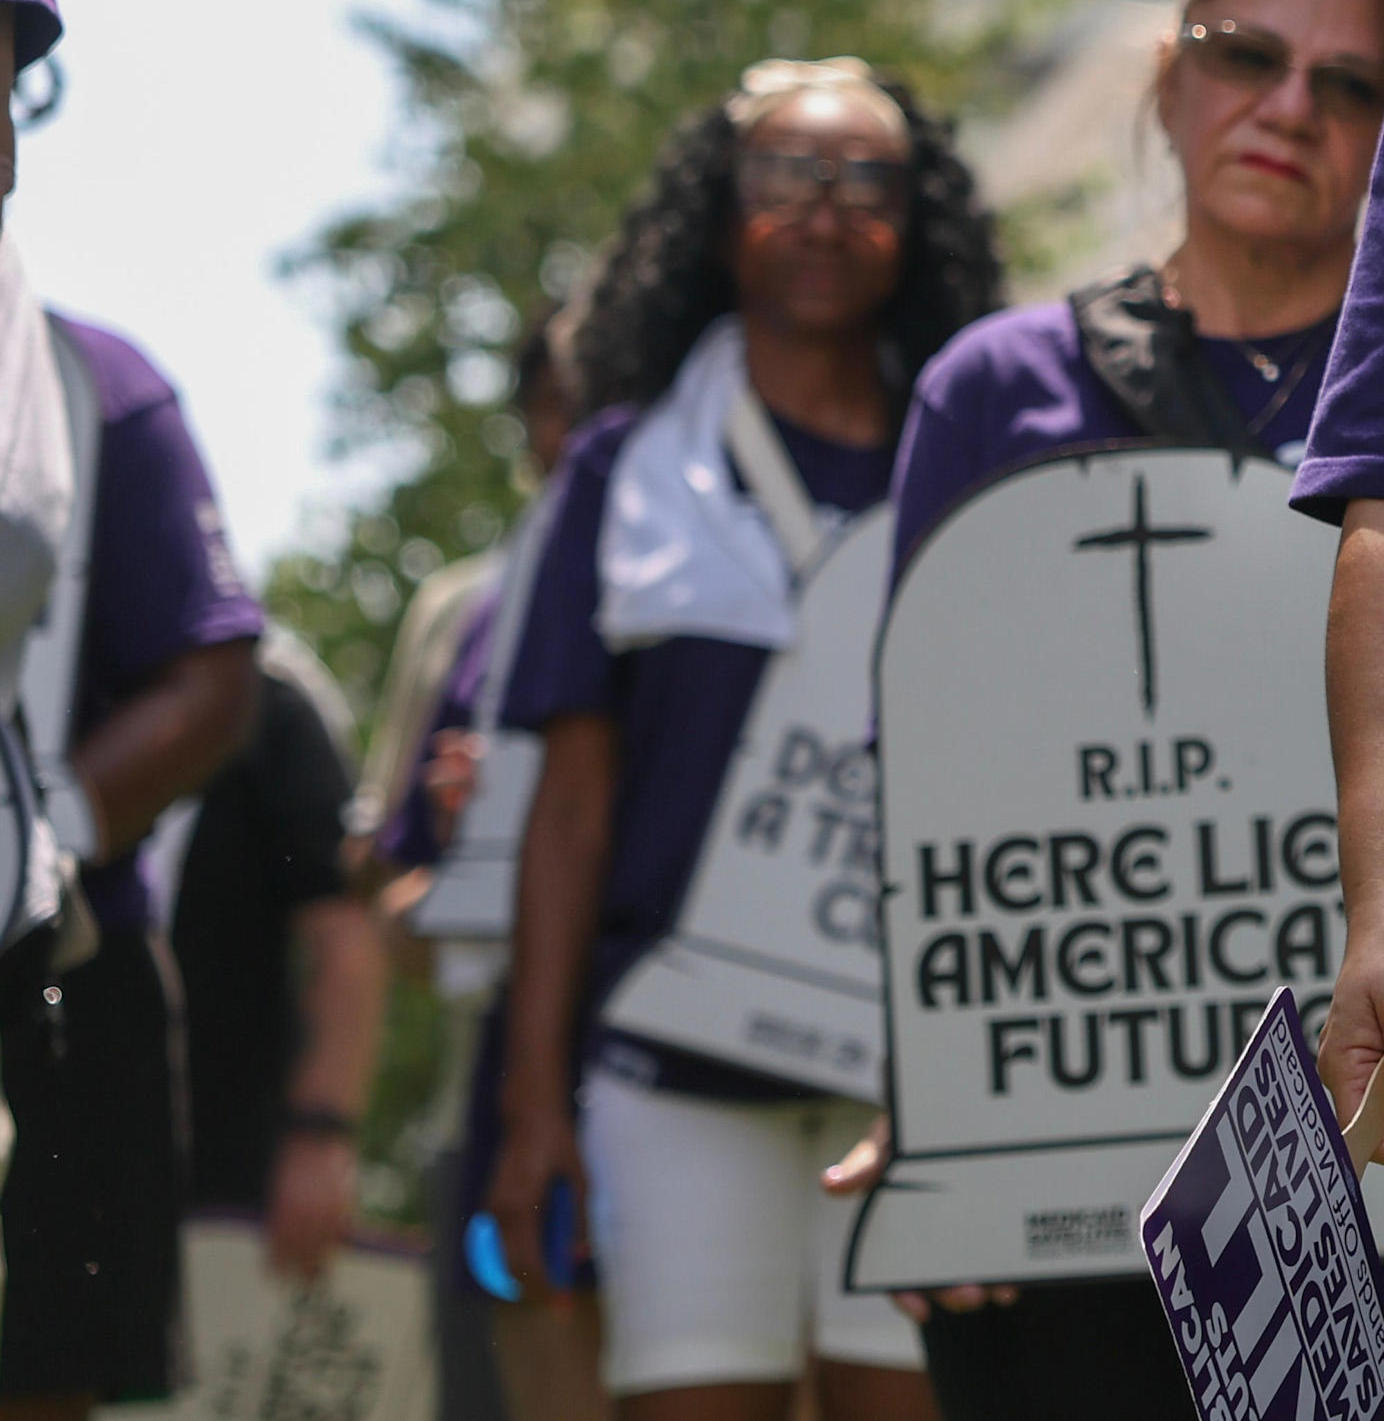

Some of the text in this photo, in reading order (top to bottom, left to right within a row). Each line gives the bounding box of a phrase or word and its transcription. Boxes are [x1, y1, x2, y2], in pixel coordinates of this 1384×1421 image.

[1080, 738, 1230, 798] R.I.P.
[919, 825, 1171, 918] HERE
[1273, 1015, 1339, 1191] Medicaid
[1255, 1047, 1377, 1413] SAVES LIVES
[1332, 1194, 1359, 1257] Off
